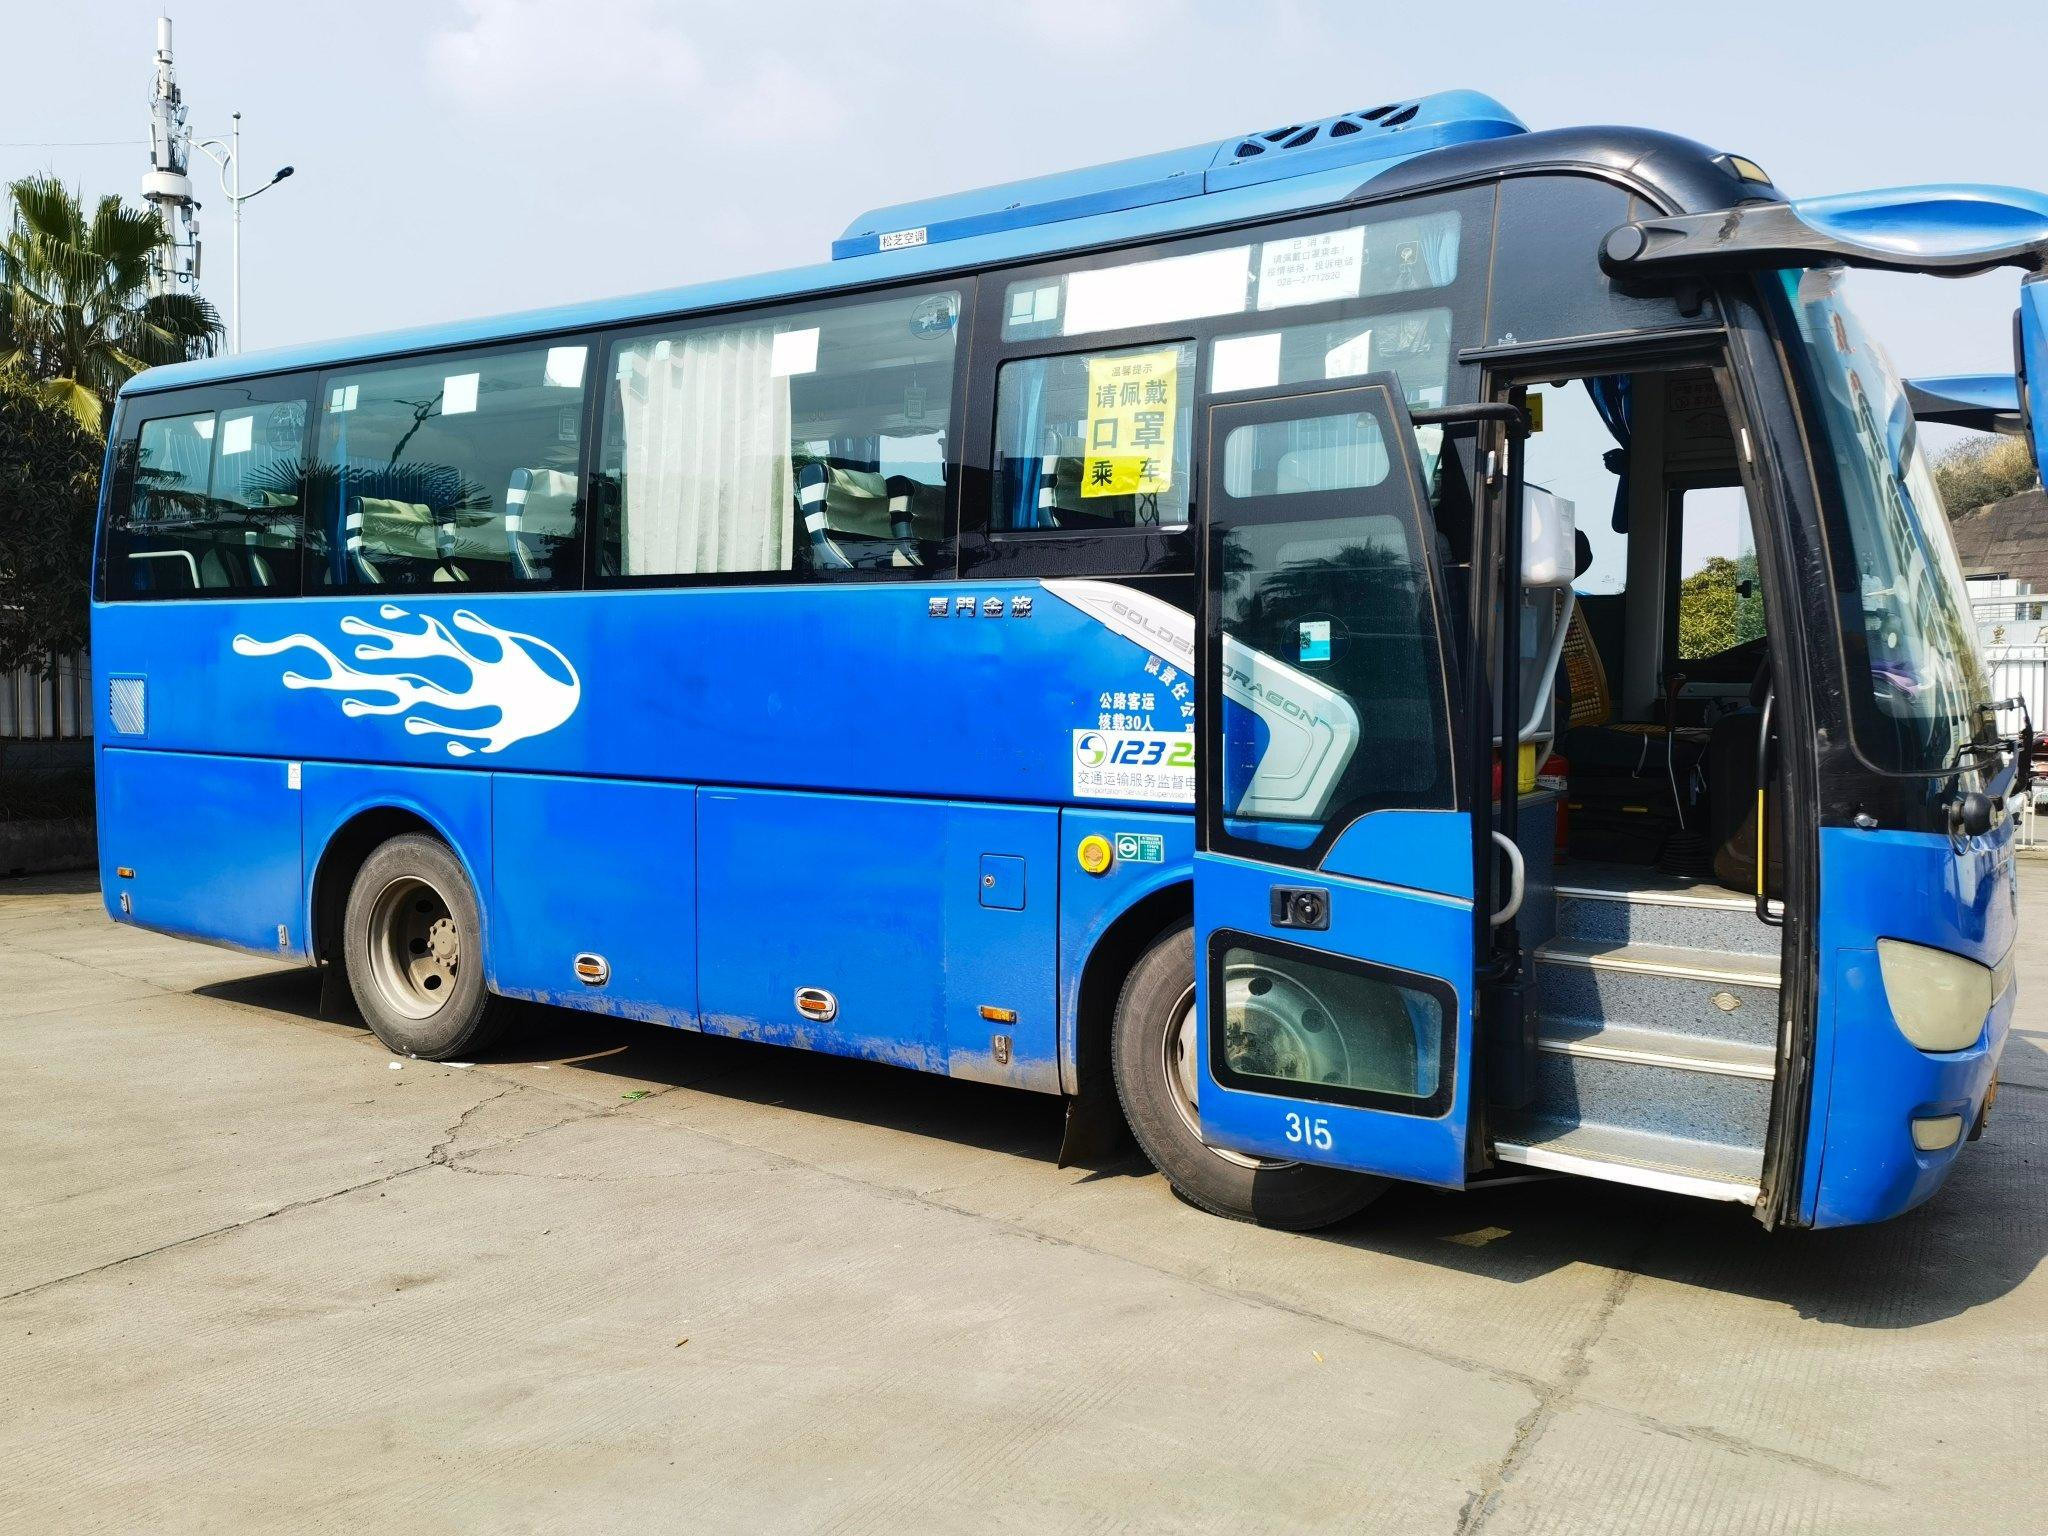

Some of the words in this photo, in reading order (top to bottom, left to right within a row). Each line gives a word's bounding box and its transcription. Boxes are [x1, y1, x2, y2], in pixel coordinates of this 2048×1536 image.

[882, 229, 925, 248] 松芝空调
[1111, 363, 1153, 377] 温馨提示
[1096, 378, 1168, 409] 请佩戴
[1092, 410, 1165, 451] 口罩
[1091, 457, 1161, 487] 乘车
[1099, 692, 1156, 711] 公路客运
[1098, 712, 1155, 731] 核载30人
[1110, 740, 1196, 768] 1232
[1285, 1112, 1332, 1150] 315
